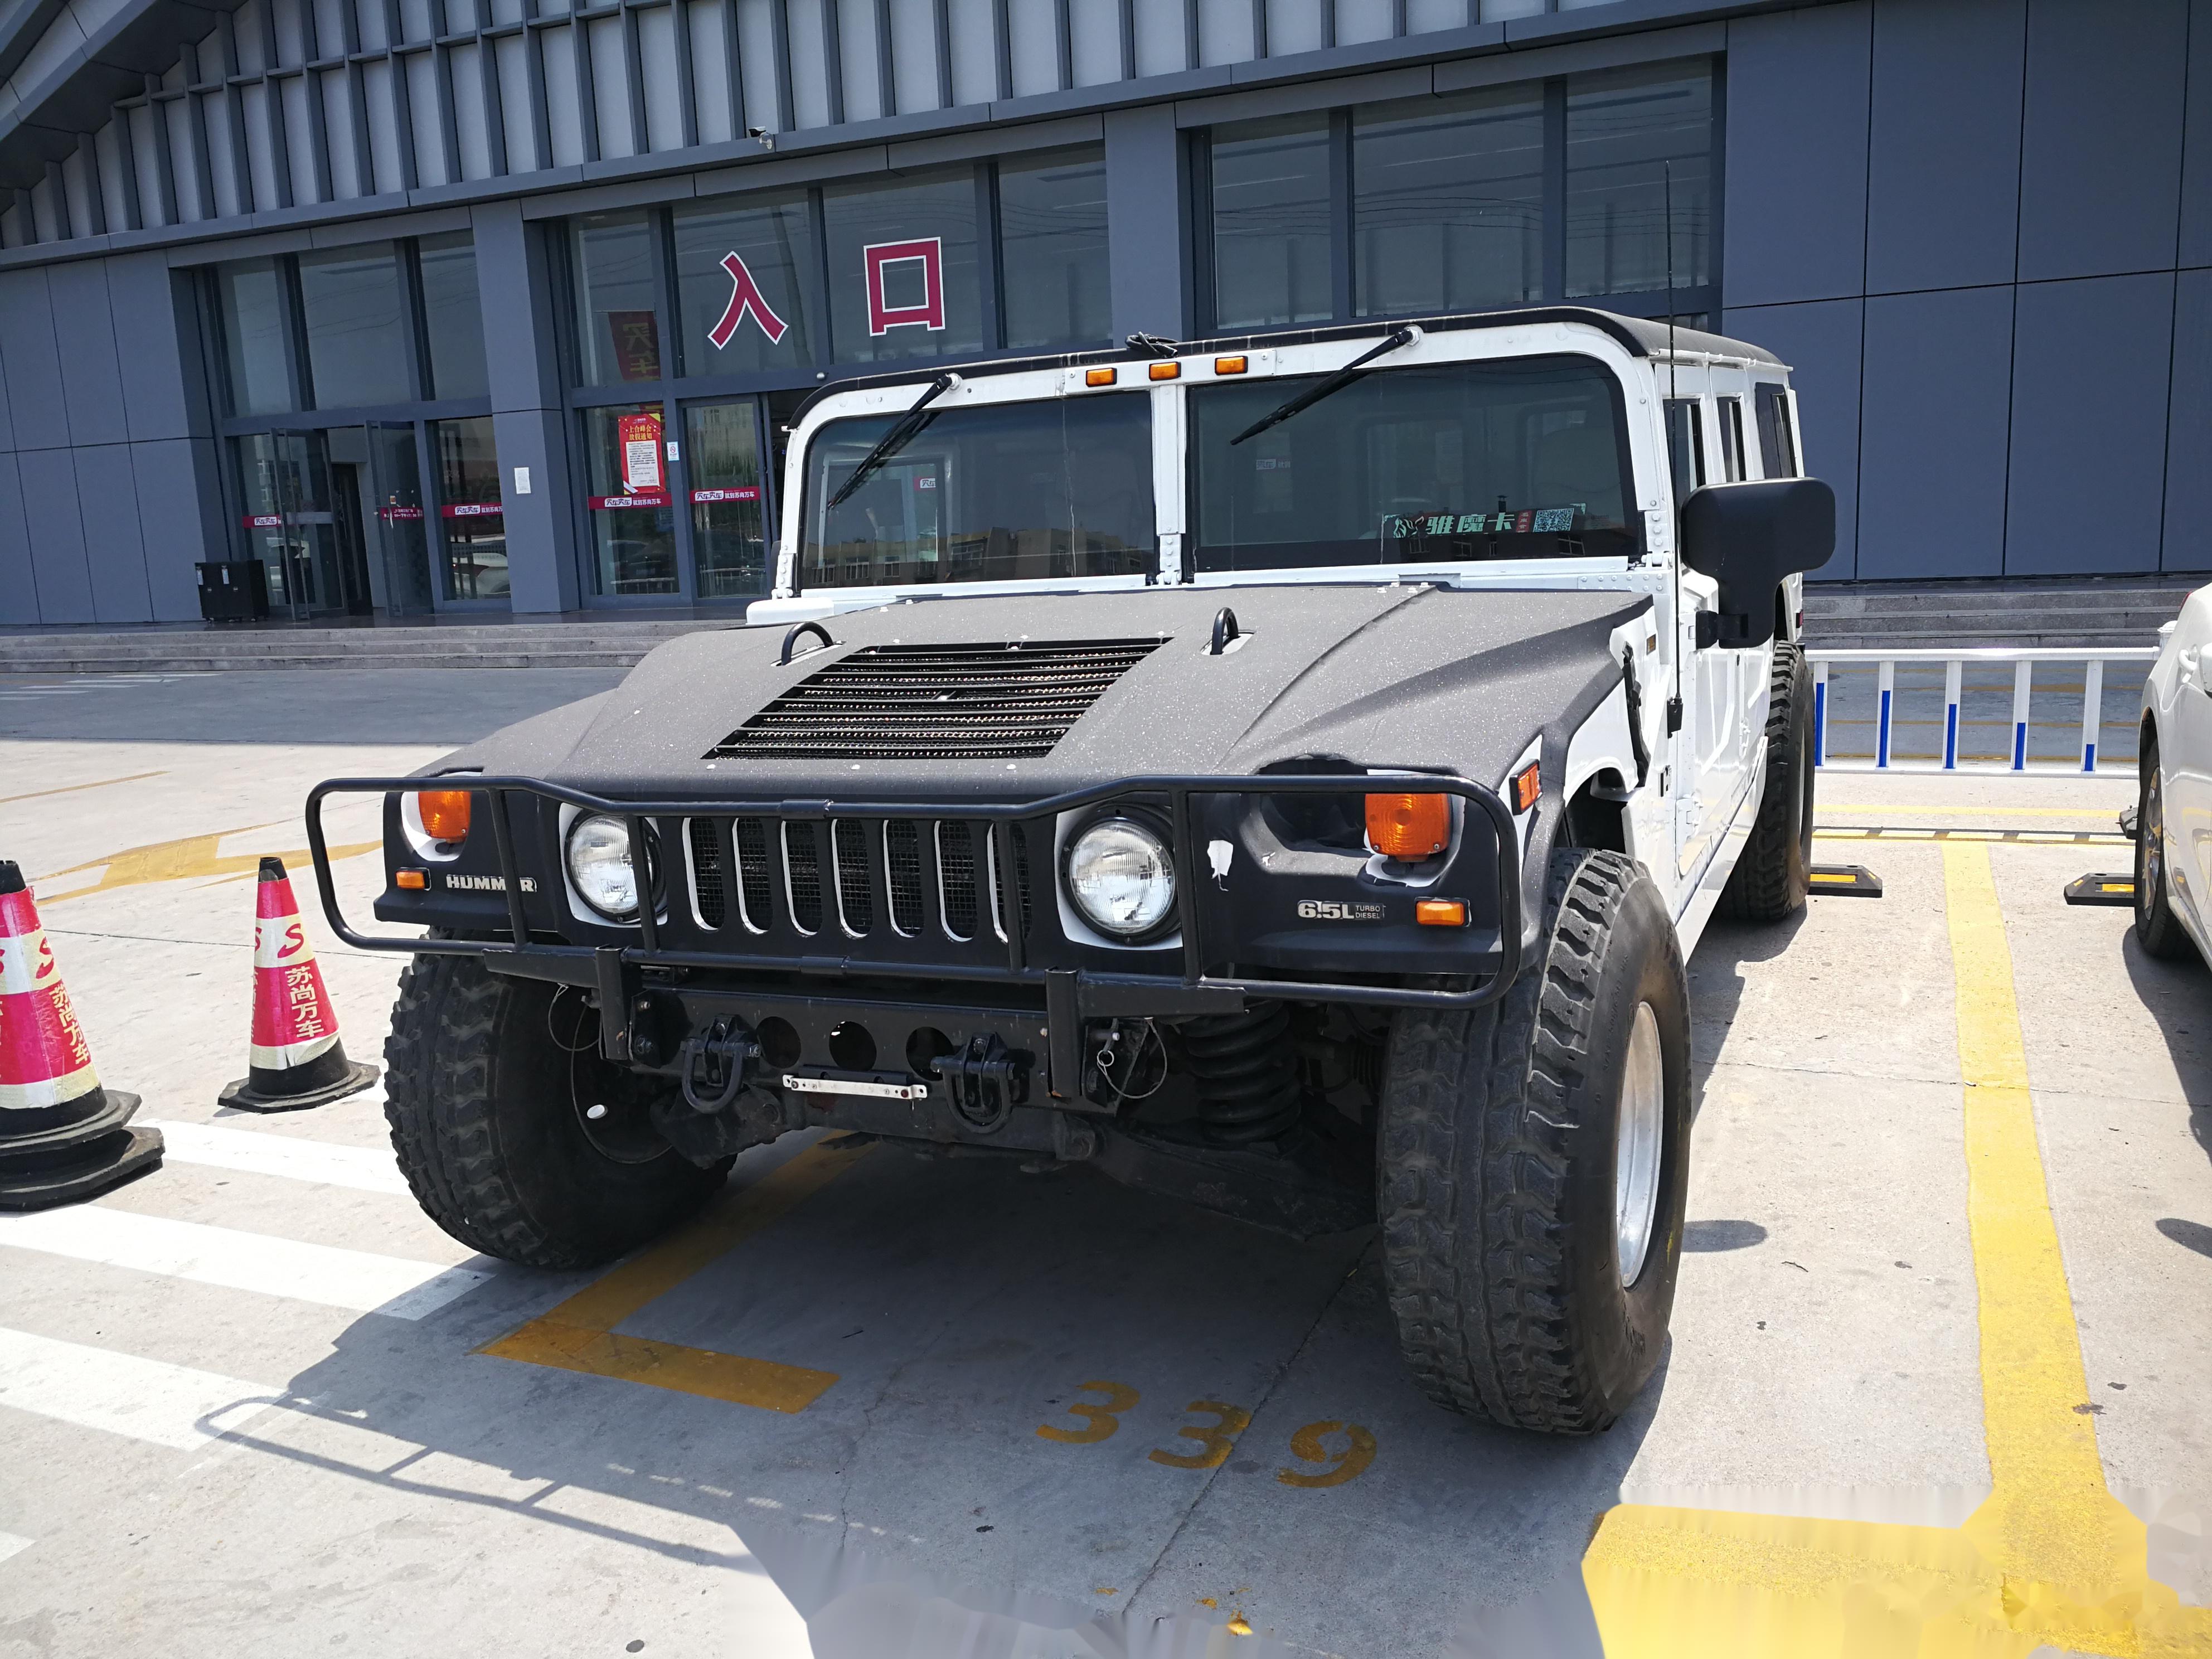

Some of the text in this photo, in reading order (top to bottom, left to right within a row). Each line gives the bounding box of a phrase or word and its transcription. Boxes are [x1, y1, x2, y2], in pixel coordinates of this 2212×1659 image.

[707, 236, 945, 350] 入口
[446, 874, 537, 892] HUMMR
[1297, 901, 1355, 919] 6.5L
[49, 983, 90, 1065] 苏尚万车
[285, 966, 324, 1038] 苏尚万车
[1035, 1380, 1377, 1488] 339
